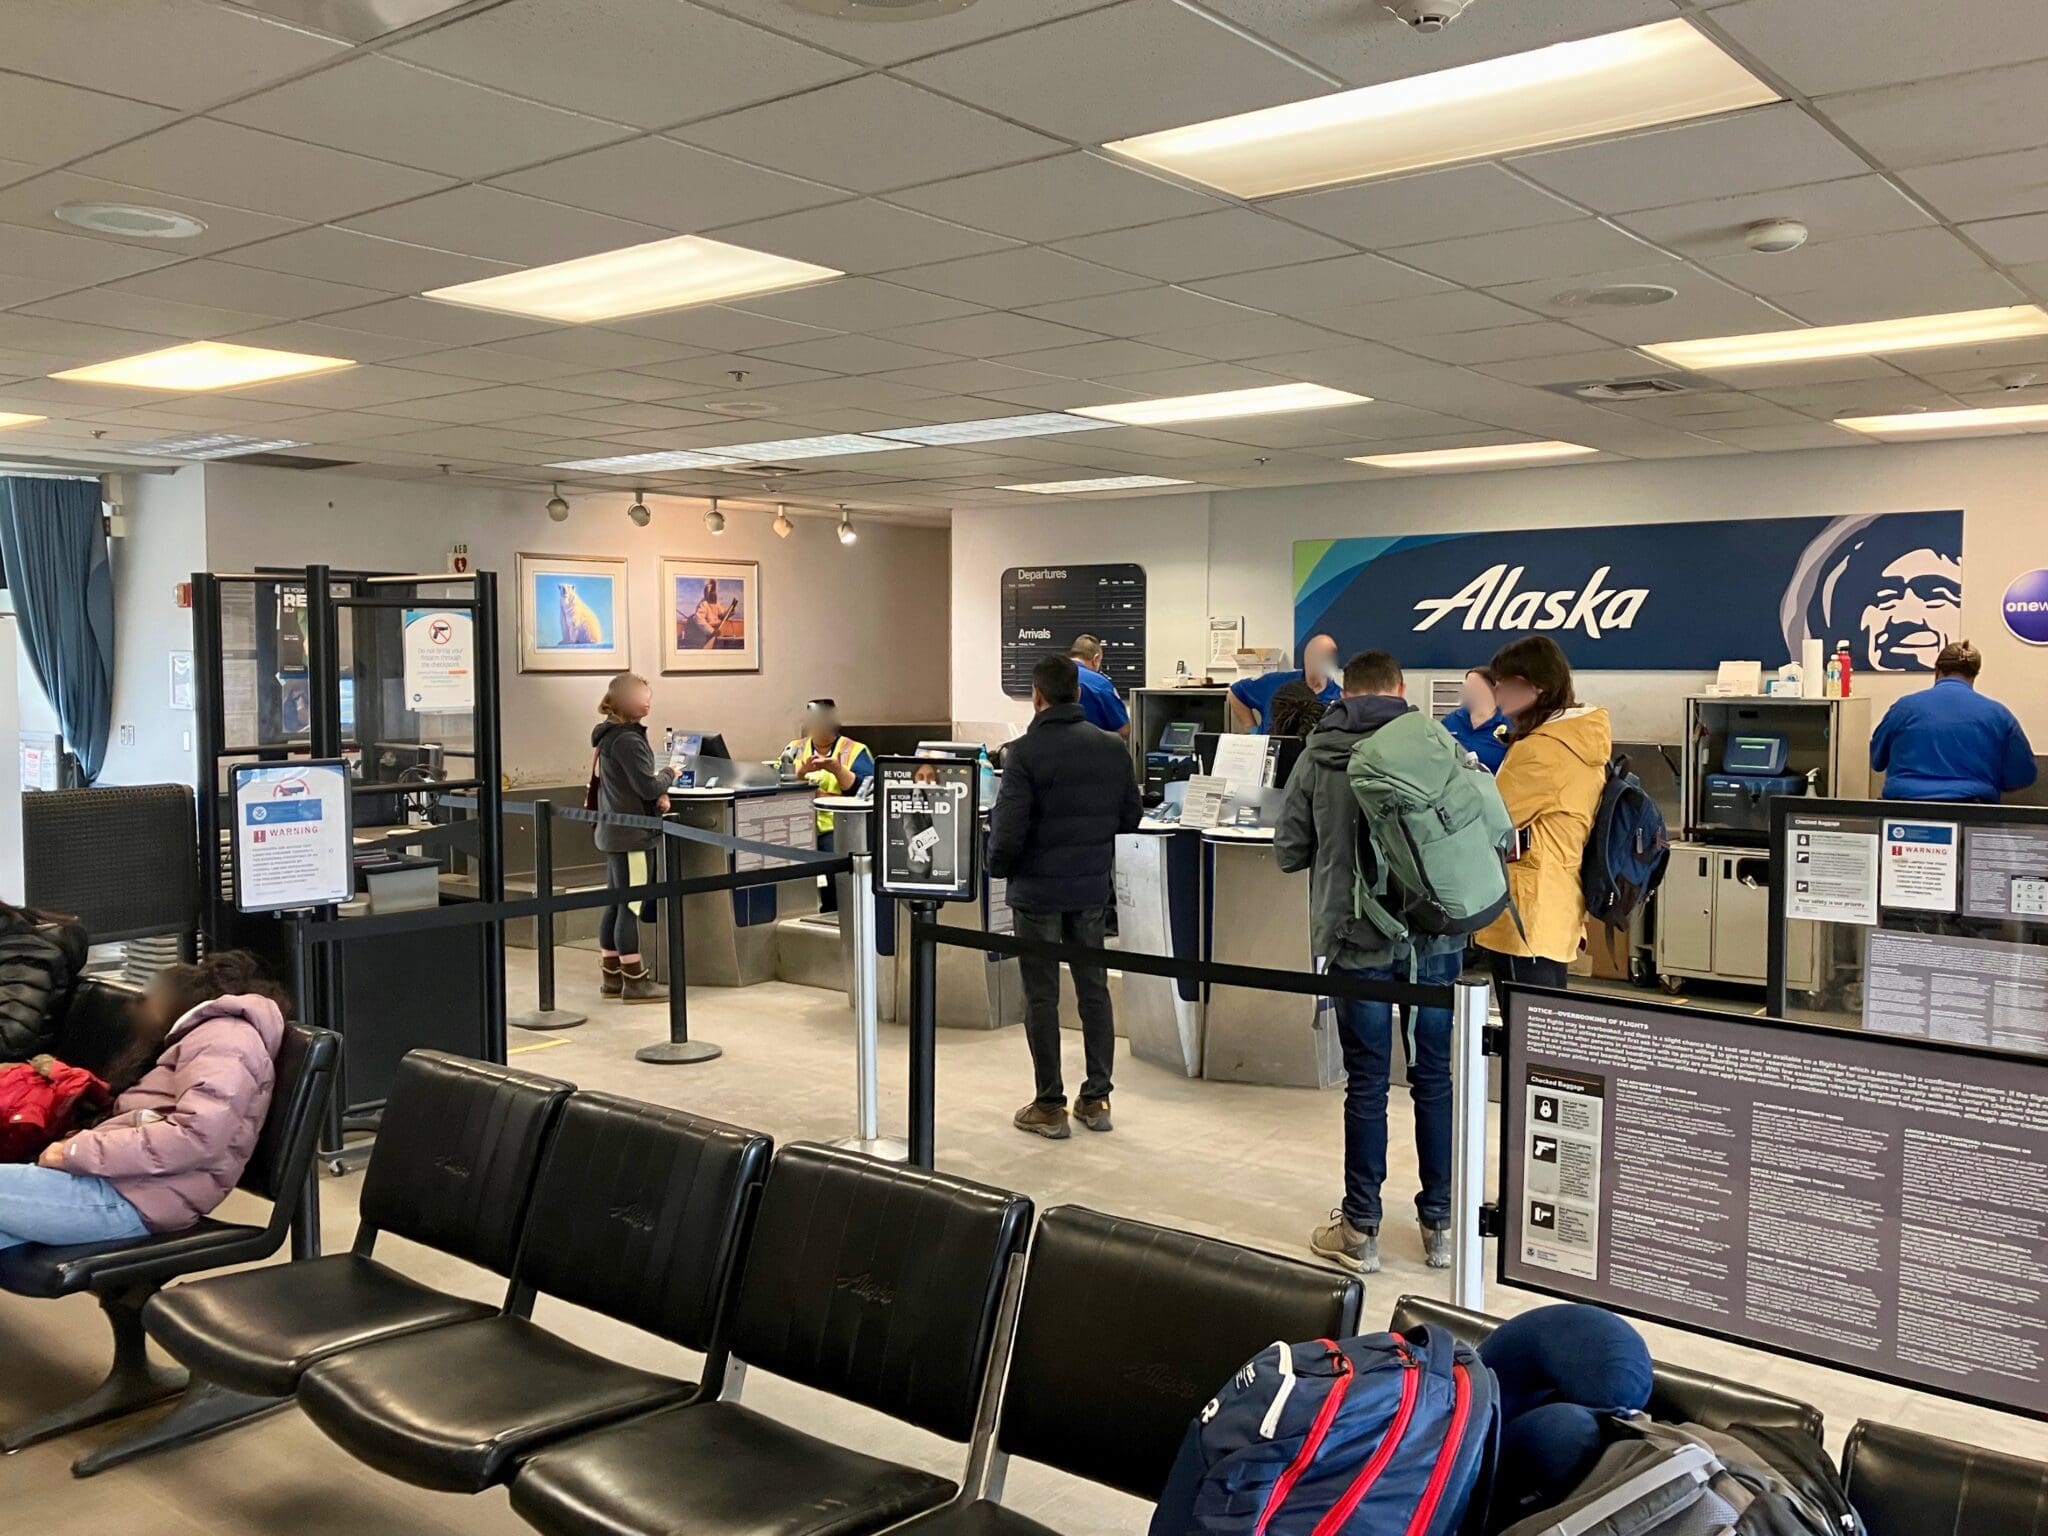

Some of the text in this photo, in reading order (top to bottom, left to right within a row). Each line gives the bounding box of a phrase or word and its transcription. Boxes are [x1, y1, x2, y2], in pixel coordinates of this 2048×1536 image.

[454, 544, 468, 554] AED
[1018, 569, 1068, 580] Departures
[1412, 564, 1650, 639] Alaska
[1018, 628, 1051, 639] Arrivals
[891, 801, 950, 814] REAL ID
[270, 826, 319, 837] WARNING
[1906, 847, 1947, 855] WARNING
[1619, 1020, 1648, 1030] FLIGHTS
[1530, 1076, 1584, 1092] Checked Baggage
